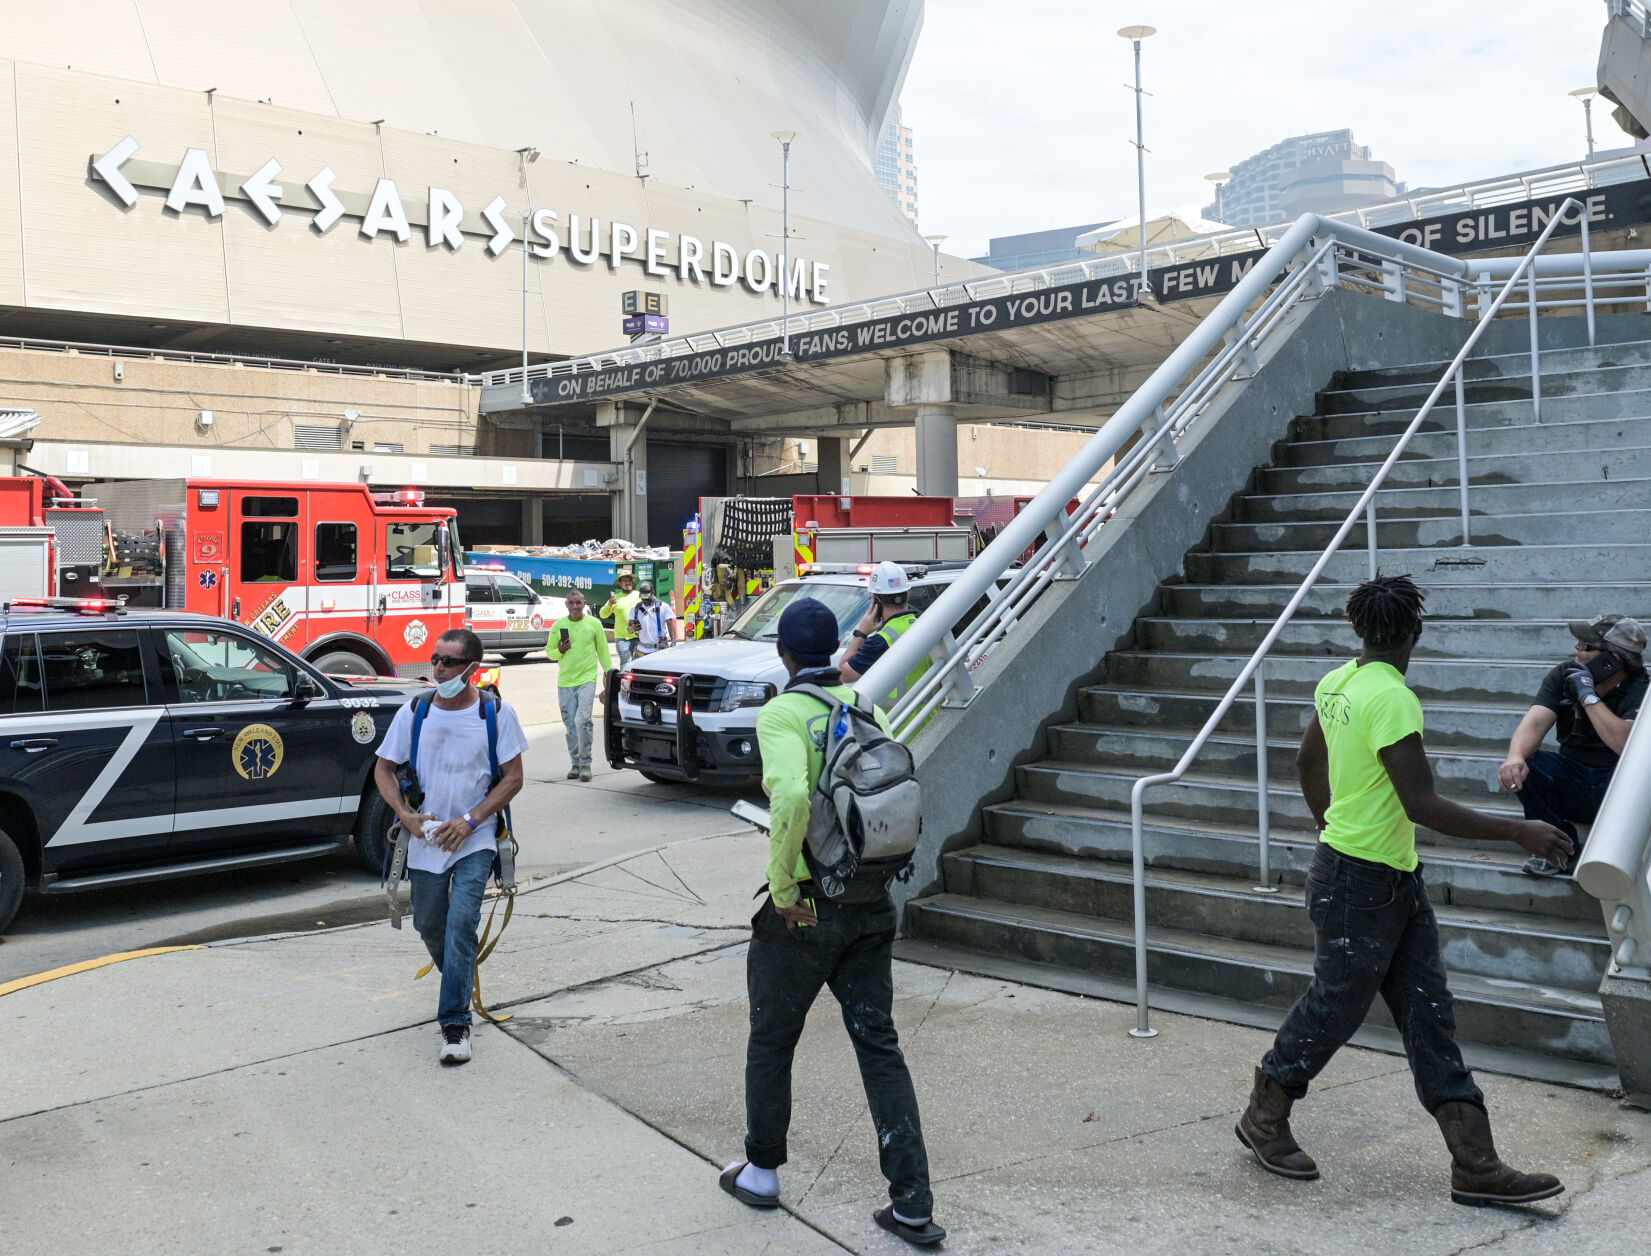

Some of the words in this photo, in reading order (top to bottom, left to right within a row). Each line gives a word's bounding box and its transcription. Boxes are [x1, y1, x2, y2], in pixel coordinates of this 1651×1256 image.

[1307, 142, 1349, 157] HYATT
[91, 134, 516, 256] CAESARS
[531, 208, 830, 304] SUPERDOME
[558, 379, 582, 396] ON
[586, 368, 641, 393] BEHALF
[645, 363, 666, 382] OF
[671, 353, 722, 379] 70,000
[726, 342, 786, 370] PROUD
[798, 330, 853, 357] FANS,
[857, 310, 959, 347] WELCOME
[968, 304, 997, 328] TO
[1006, 290, 1073, 321] YOUR
[1081, 278, 1143, 309] LAST
[1162, 263, 1220, 295] FEW
[1399, 223, 1442, 249] OF
[624, 292, 635, 312] E
[647, 296, 659, 311] E
[200, 544, 217, 557] 9
[391, 590, 421, 599] CLASS
[250, 592, 277, 621] ORLEANS
[253, 598, 292, 637] IRE
[341, 698, 380, 708] 3032
